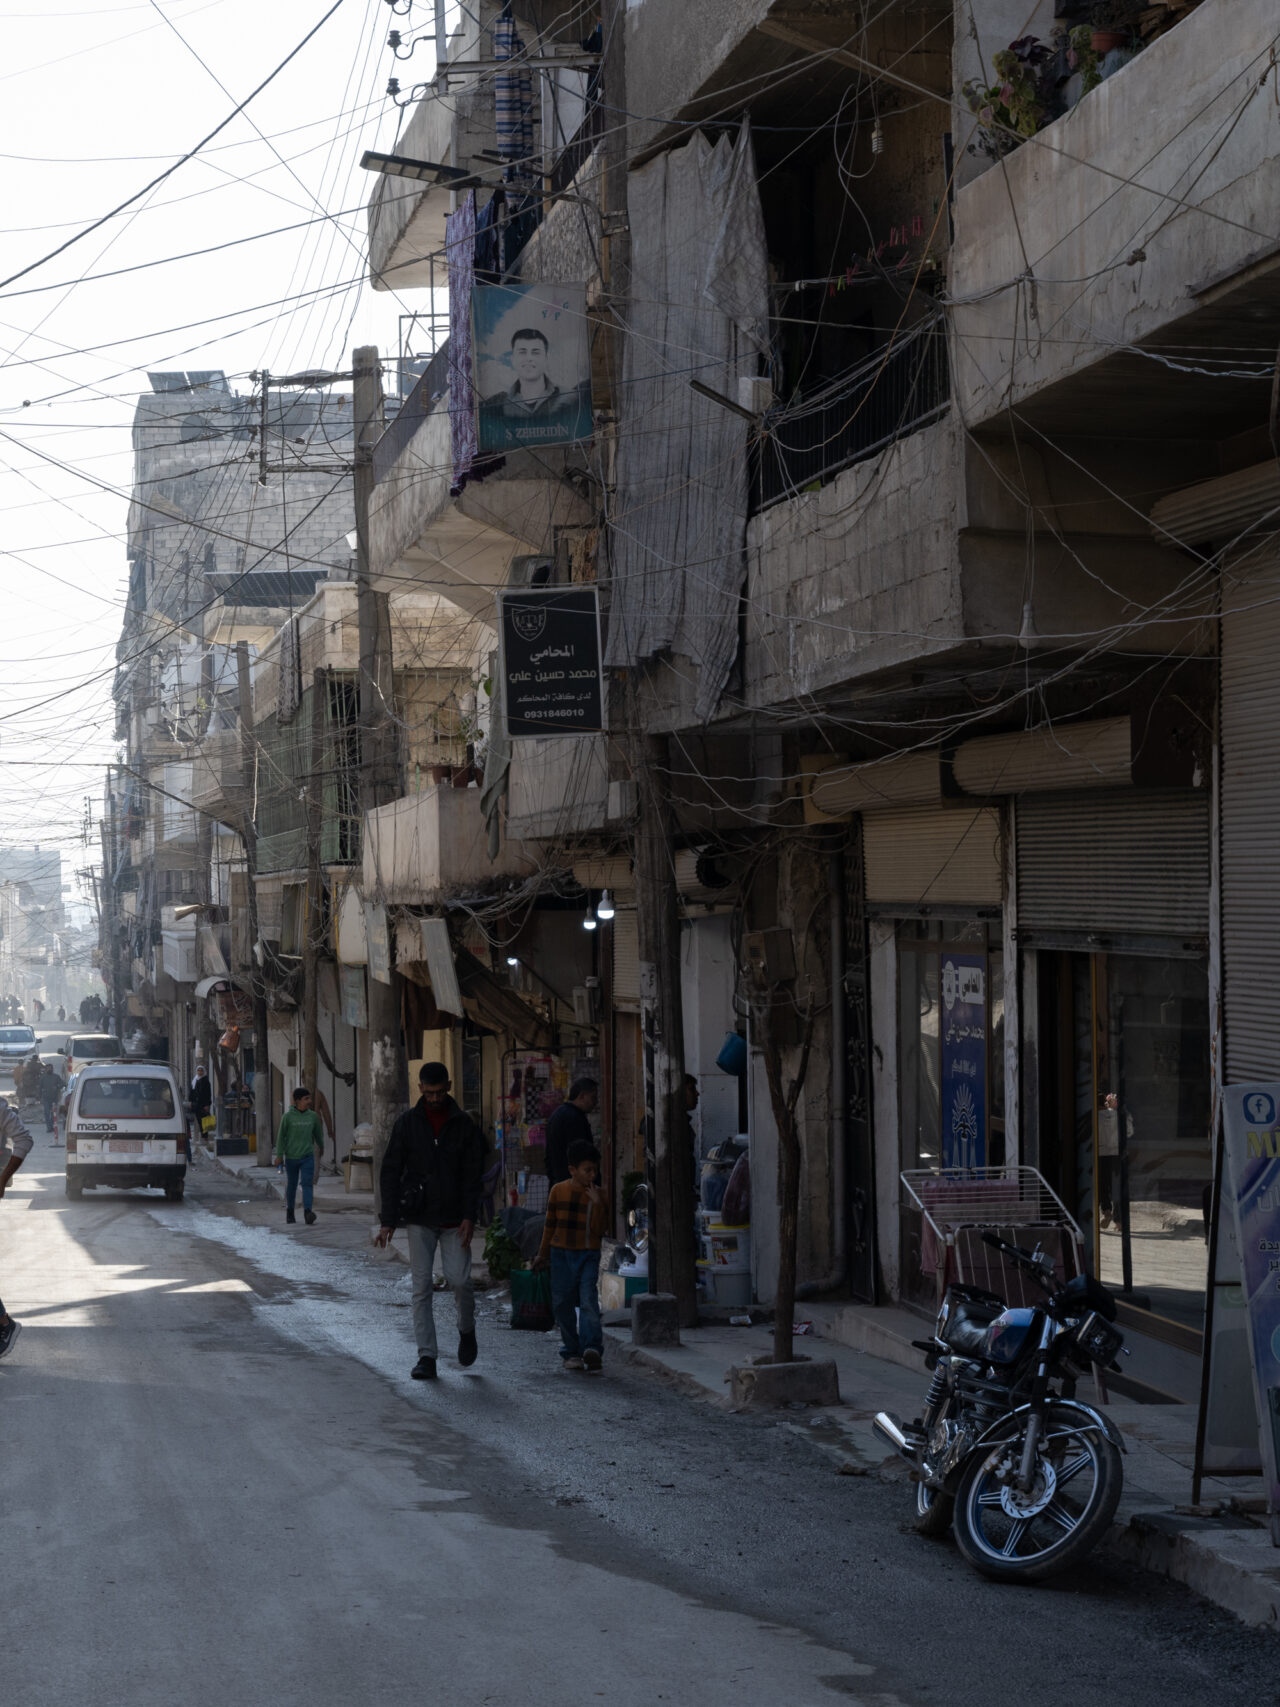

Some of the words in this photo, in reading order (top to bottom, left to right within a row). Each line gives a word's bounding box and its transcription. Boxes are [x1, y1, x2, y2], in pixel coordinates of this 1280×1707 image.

[529, 644, 574, 664] المحامي
[509, 669, 532, 684] علي
[535, 669, 566, 682] حسين
[568, 669, 597, 679] محمد
[516, 693, 551, 704] المحاكم
[552, 692, 575, 702] كافة
